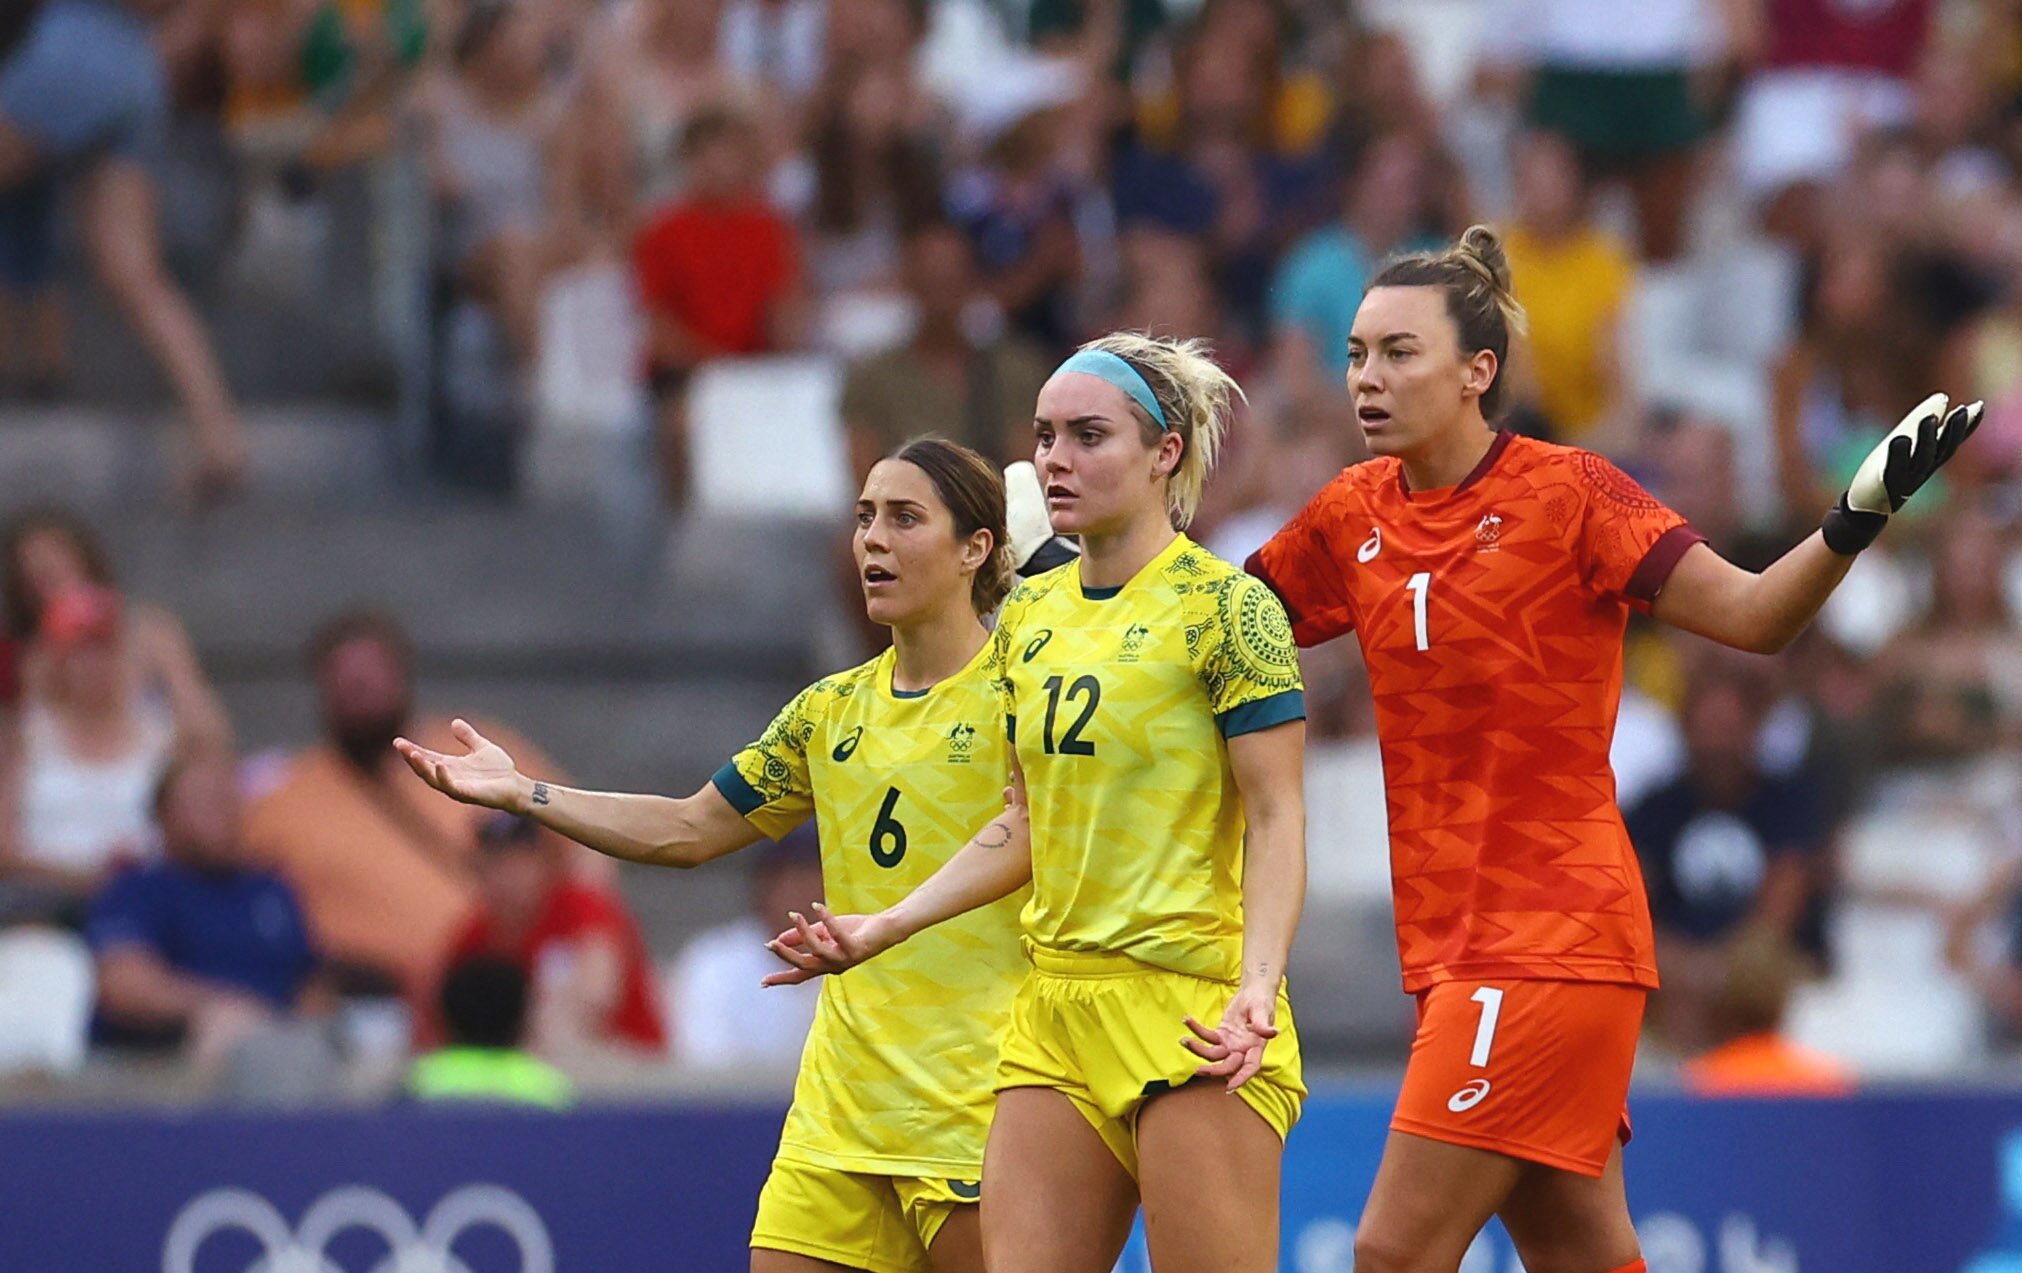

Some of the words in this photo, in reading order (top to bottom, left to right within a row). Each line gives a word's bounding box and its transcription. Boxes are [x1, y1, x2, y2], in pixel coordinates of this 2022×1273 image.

[1405, 572, 1431, 651] 1
[1042, 674, 1101, 757] 12
[869, 785, 907, 869] 6
[1470, 986, 1504, 1068] 1
